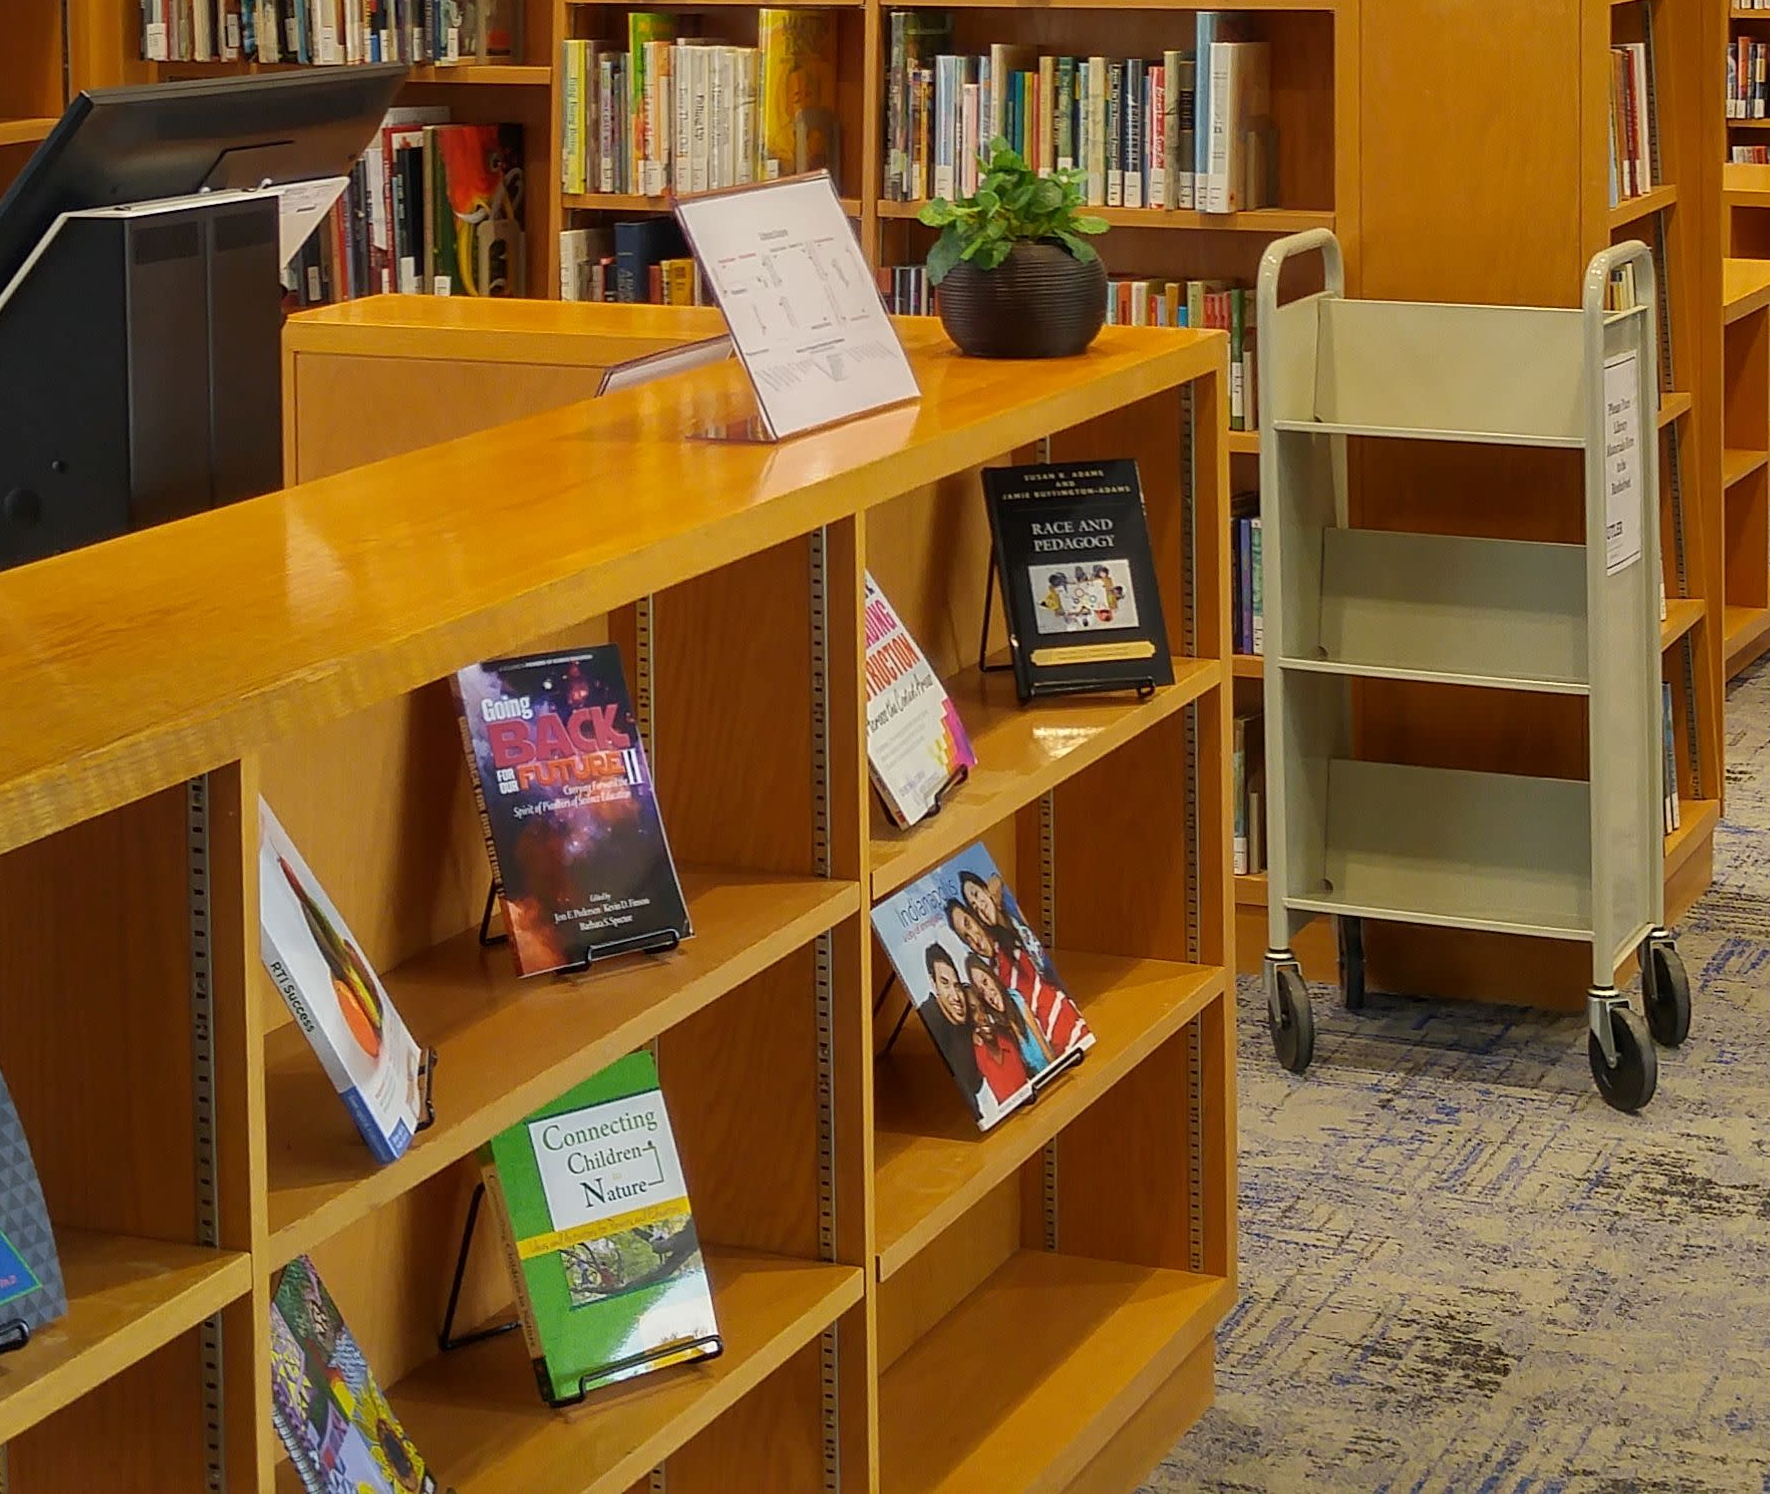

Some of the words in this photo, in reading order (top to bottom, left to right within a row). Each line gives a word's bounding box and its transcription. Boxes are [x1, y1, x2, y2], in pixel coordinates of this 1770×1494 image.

[694, 94, 706, 126] Falling
[694, 126, 706, 141] Up
[1023, 472, 1056, 482] SUSAN
[1071, 470, 1105, 479] ADAMS
[1055, 480, 1076, 488] AND
[1002, 491, 1031, 501] JAMIE
[1031, 520, 1074, 536] RACE
[1079, 518, 1114, 533] AND
[1034, 534, 1116, 553] PEDAGOGY
[481, 696, 533, 723] Going
[485, 703, 631, 769] BACK
[496, 767, 516, 783] FOR
[516, 749, 627, 791] FUTURE
[622, 748, 645, 785] II
[498, 781, 521, 796] OUR
[512, 804, 535, 820] Spirit
[270, 961, 289, 986] RTI
[283, 984, 317, 1034] Success
[542, 1110, 659, 1152] Connecting
[567, 1145, 642, 1175] Children
[579, 1178, 648, 1208] Nature
